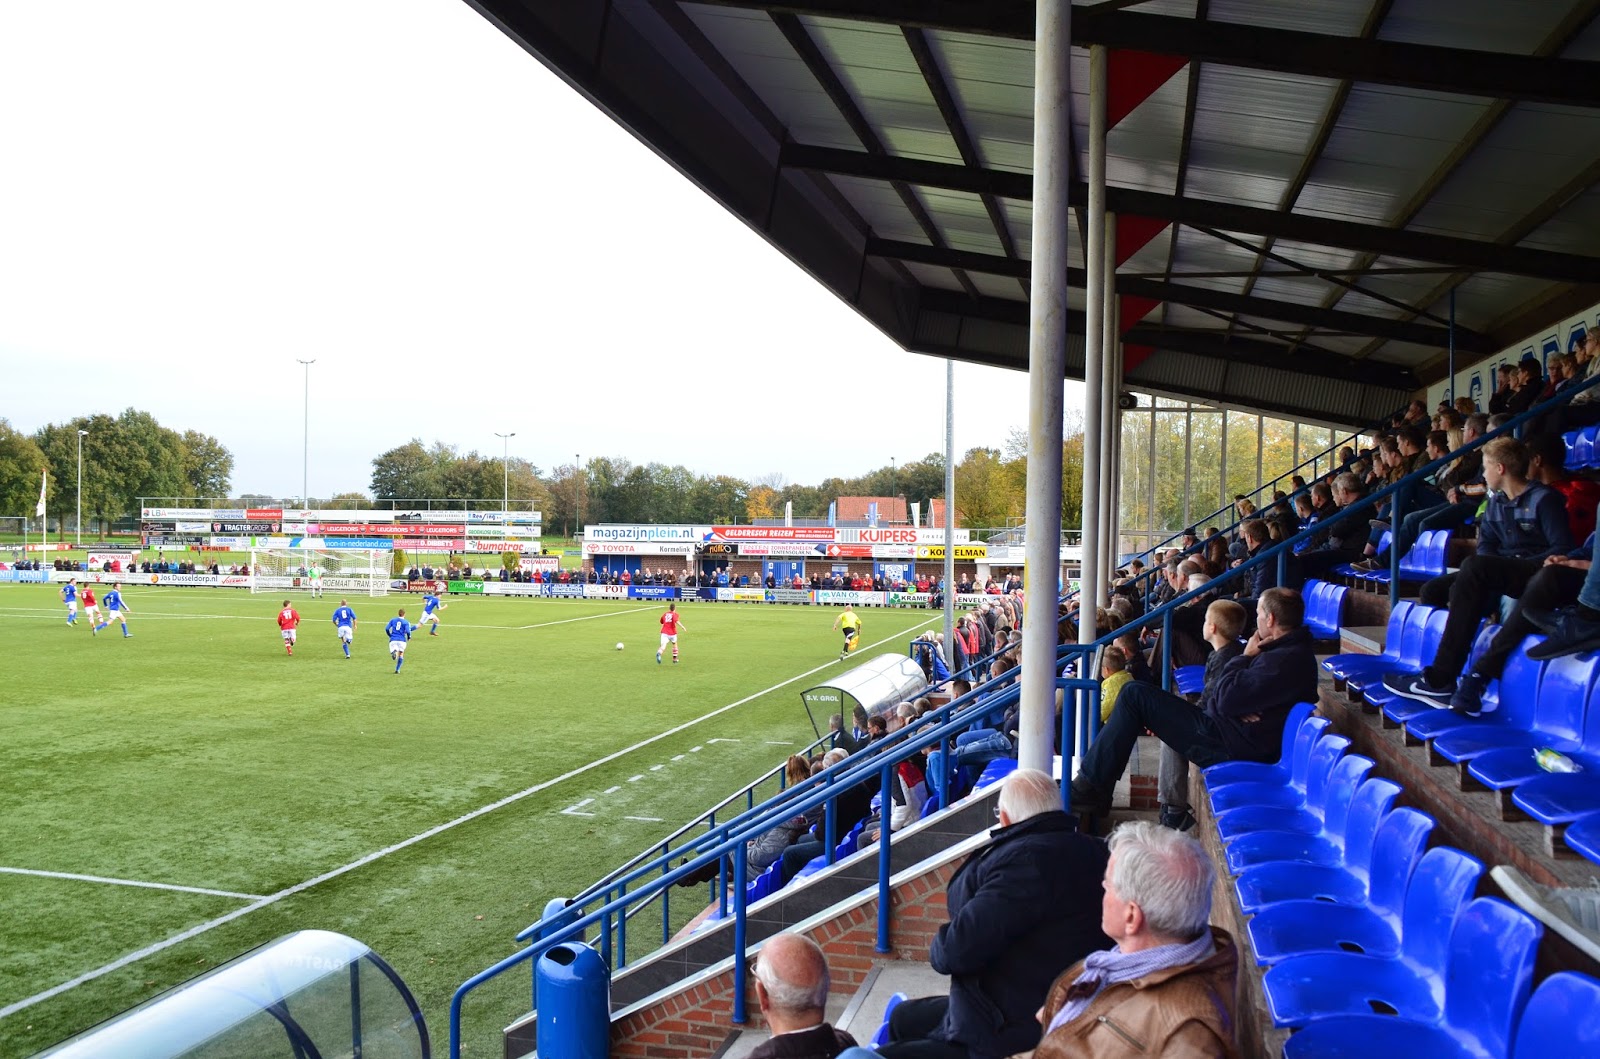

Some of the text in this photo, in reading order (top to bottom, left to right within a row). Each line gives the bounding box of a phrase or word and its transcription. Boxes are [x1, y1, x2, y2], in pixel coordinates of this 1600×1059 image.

[593, 527, 694, 540] magazijnplein.nl
[860, 530, 917, 543] KUIPERS
[477, 540, 524, 551] bumatrac
[930, 549, 986, 557] KOELMAN
[172, 575, 218, 583] Dusseldorp.nl
